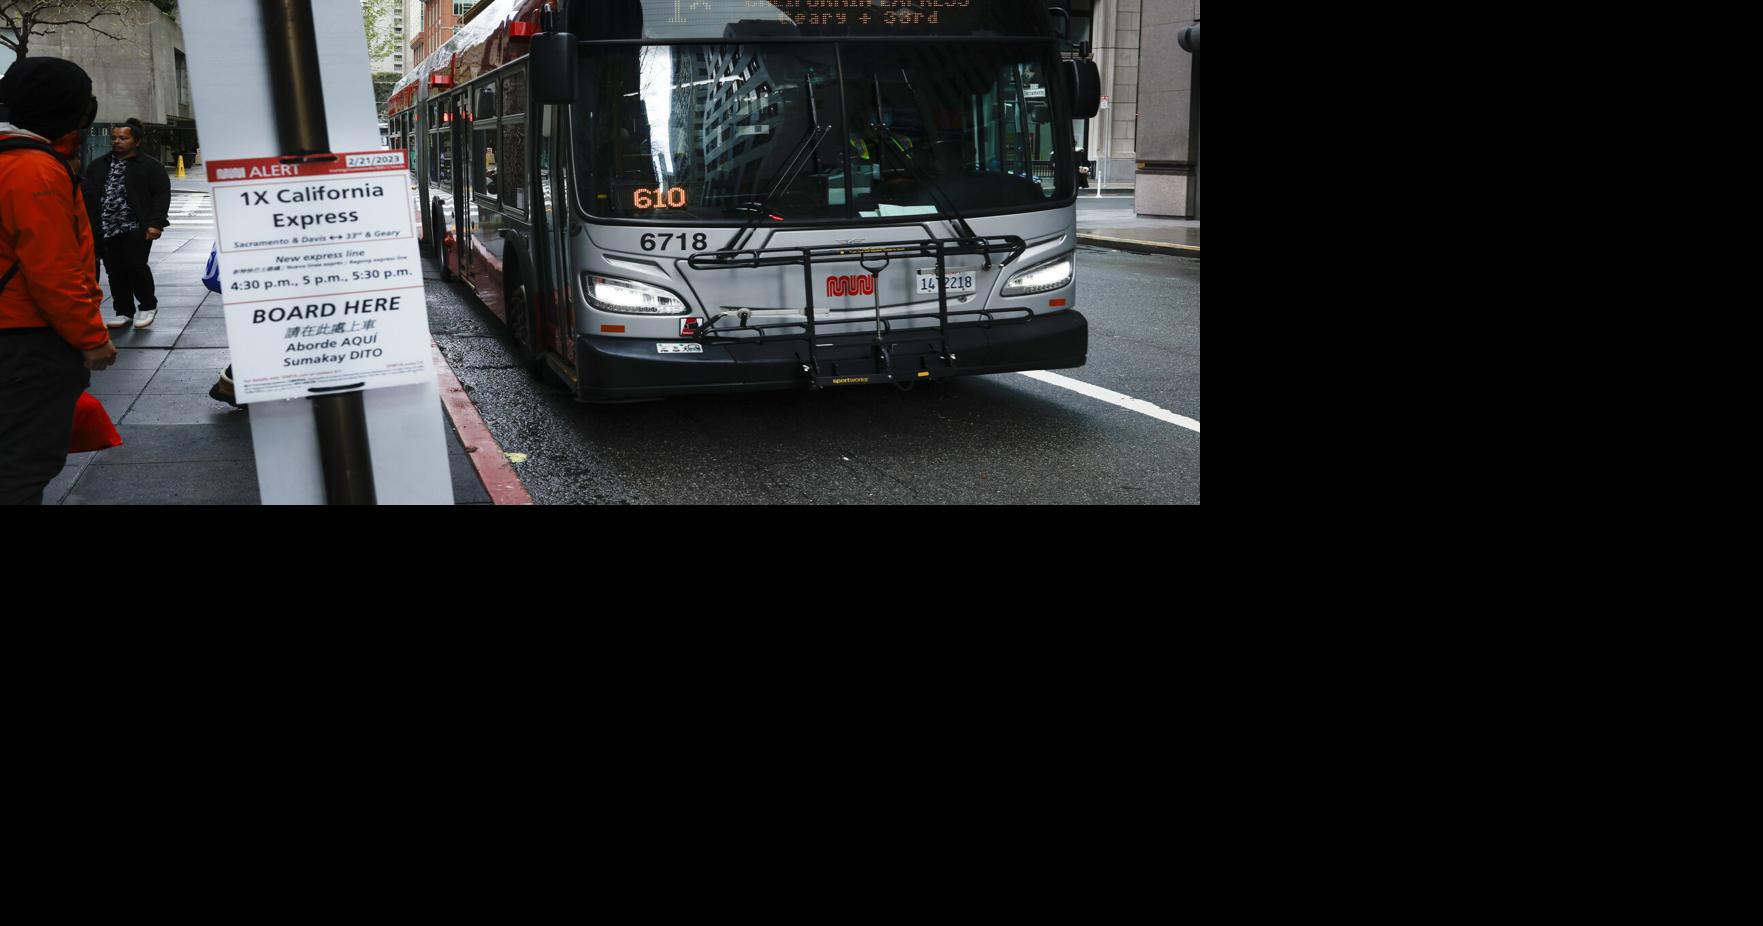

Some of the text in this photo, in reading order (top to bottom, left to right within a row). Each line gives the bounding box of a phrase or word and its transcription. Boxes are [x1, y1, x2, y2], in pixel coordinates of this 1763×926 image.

[348, 155, 400, 166] 2/21/2023
[249, 163, 299, 178] ALERT
[240, 183, 384, 206] 1X California
[633, 187, 687, 209] 610
[273, 210, 359, 230] Express
[233, 238, 289, 249] Sacramento
[302, 235, 326, 244] Davis
[640, 232, 708, 251] 6718
[275, 255, 301, 263] New
[303, 252, 343, 263] express
[230, 268, 413, 290] 4:30 p.m., 5 p.m., 5:30 p.m.
[921, 275, 972, 291] 142218
[252, 296, 401, 324] BOARD HERE
[285, 332, 377, 353] Aborde AQUÍ
[283, 348, 383, 367] Sumakay DITO
